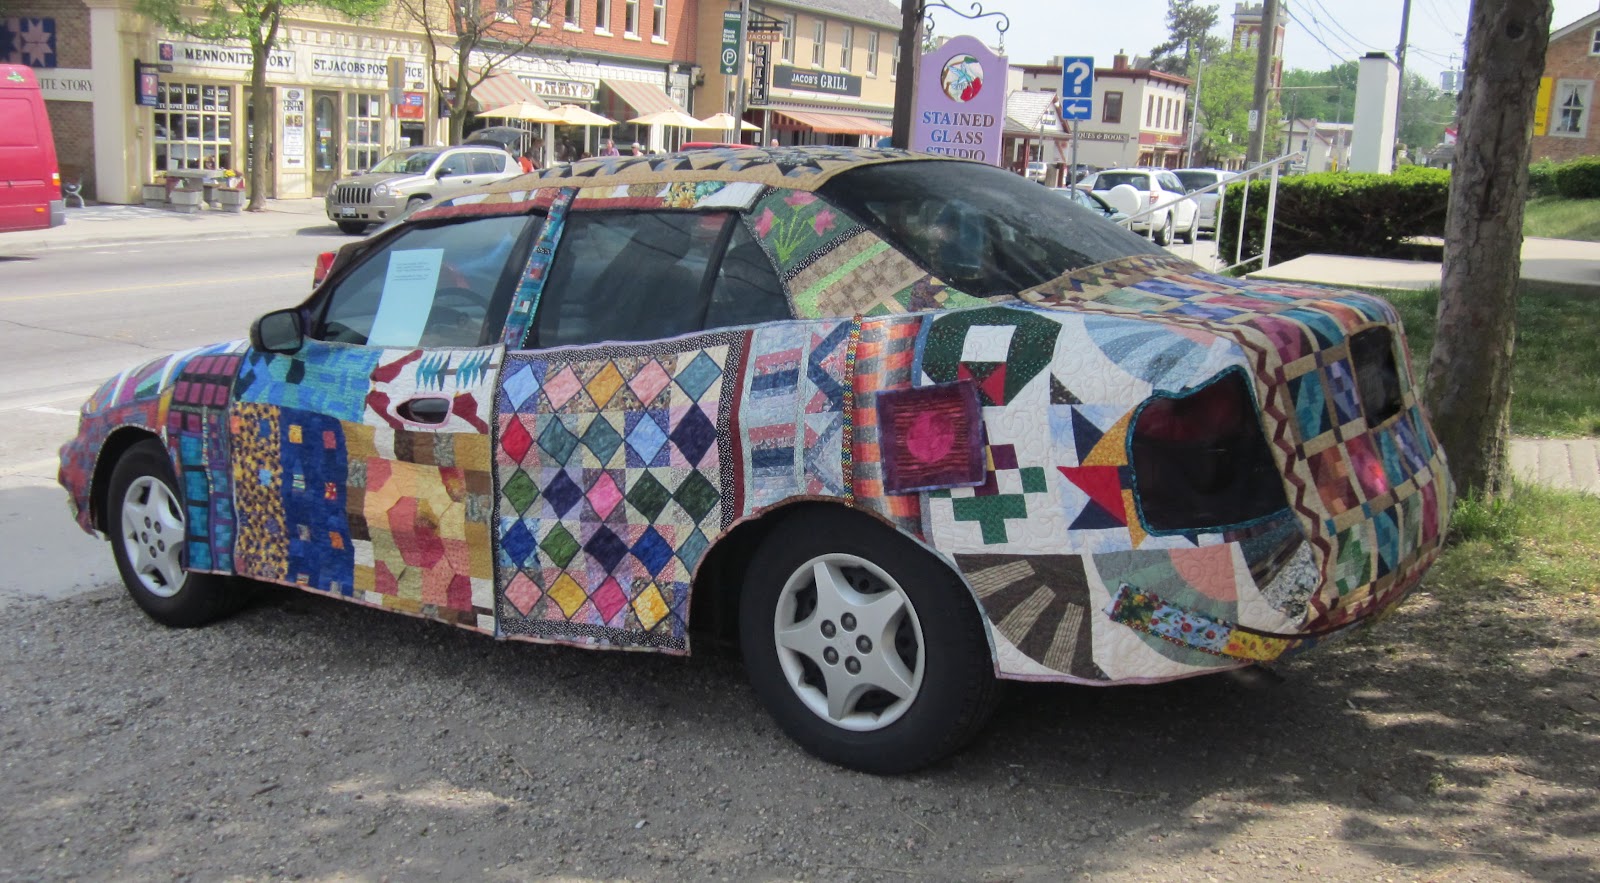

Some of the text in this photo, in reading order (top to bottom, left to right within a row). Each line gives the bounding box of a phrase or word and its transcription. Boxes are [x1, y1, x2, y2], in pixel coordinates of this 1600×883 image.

[185, 48, 253, 65] MENNONITE
[269, 55, 292, 67] ORY
[314, 59, 327, 70] ST.
[328, 60, 365, 73] JACOBS
[754, 45, 765, 99] GRILL
[60, 79, 93, 92] STORY
[535, 82, 578, 96] BAKERY
[791, 73, 847, 90] JACOB'S GRILL
[922, 111, 995, 127] STAINED
[931, 129, 983, 144] GLASS
